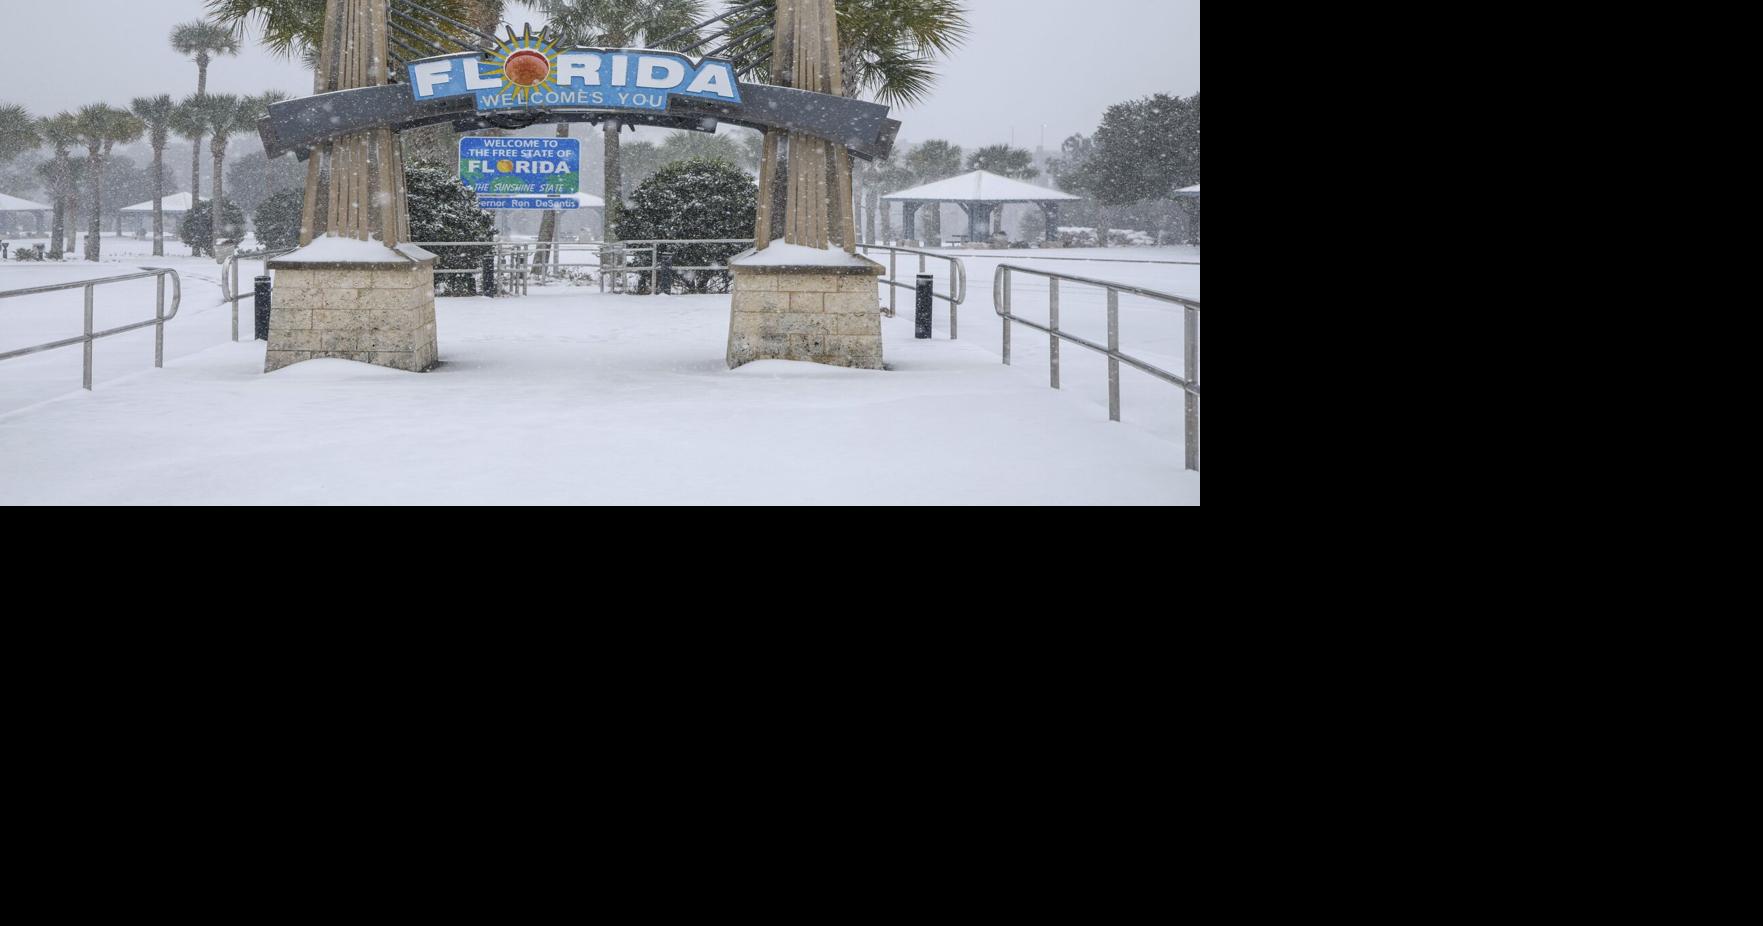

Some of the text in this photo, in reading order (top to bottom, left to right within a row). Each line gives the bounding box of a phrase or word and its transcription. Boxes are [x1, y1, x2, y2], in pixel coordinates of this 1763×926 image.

[415, 48, 734, 97] FLORIDA
[482, 91, 663, 107] WELCOMES YOU
[484, 139, 558, 148] WELCOME TO
[468, 149, 572, 158] THE FREE STATE OF
[468, 160, 571, 174] FLORIDA
[473, 183, 564, 192] THE SUNSHINE STATE
[511, 200, 530, 208] Ron
[535, 199, 576, 208] DeSantis
